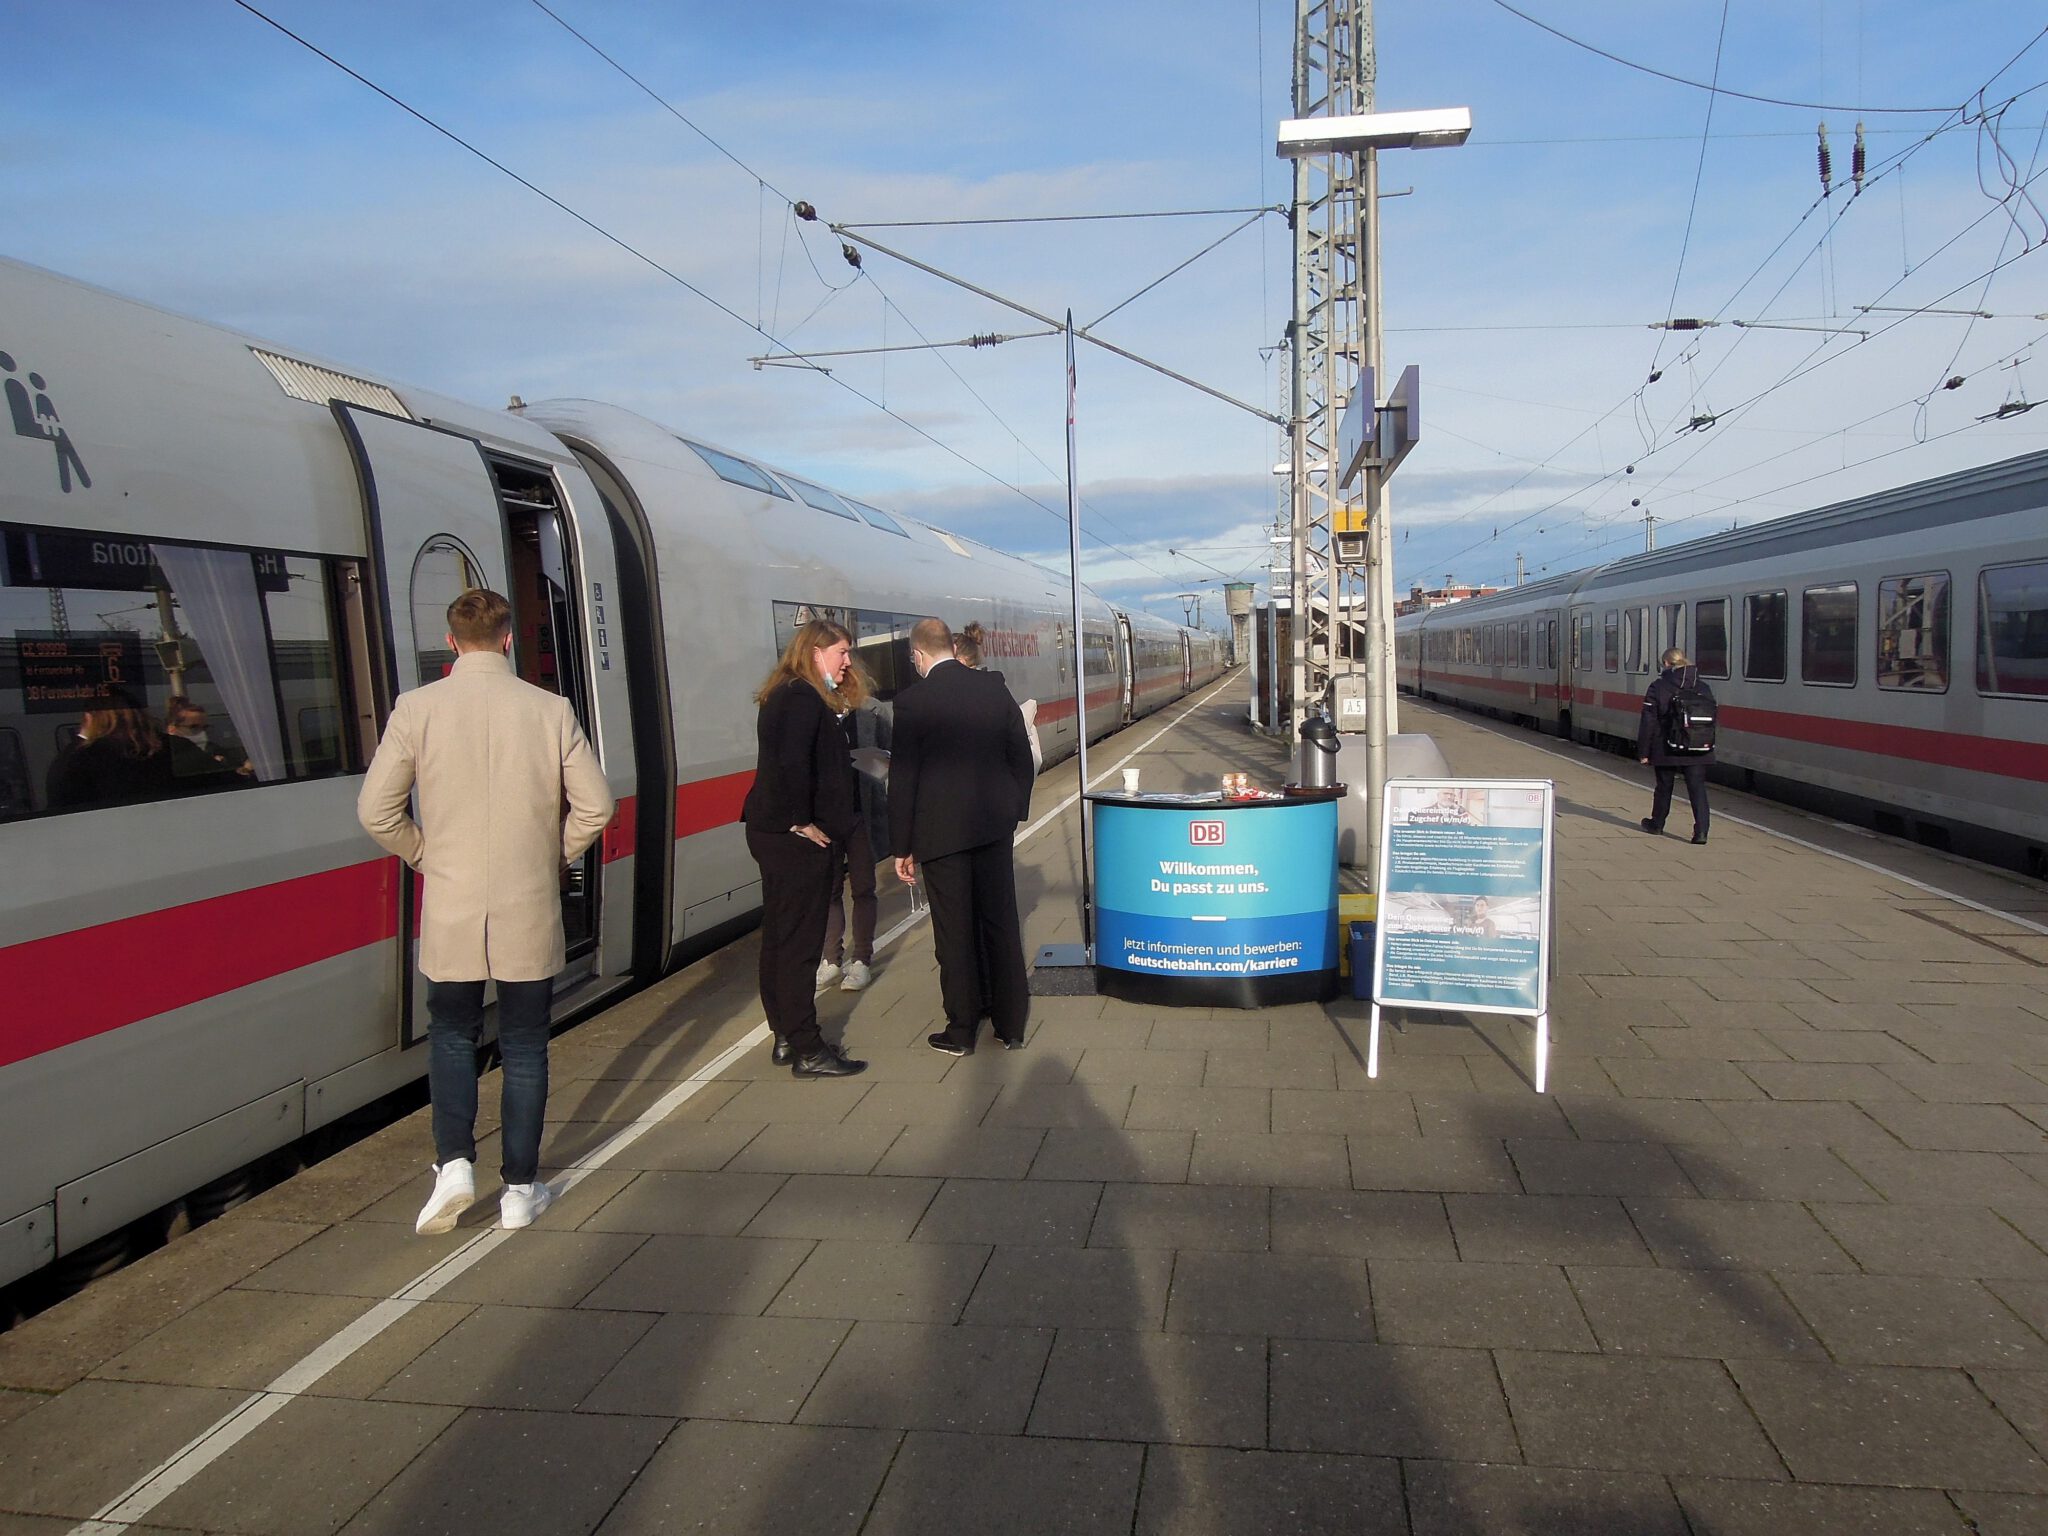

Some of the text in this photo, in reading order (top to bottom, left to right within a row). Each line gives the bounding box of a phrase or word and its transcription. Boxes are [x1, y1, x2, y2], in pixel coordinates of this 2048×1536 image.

[982, 623, 1040, 657] ordrestaurant
[1193, 825, 1221, 842] DB
[1159, 861, 1259, 877] Willkommen,
[1151, 879, 1269, 896] Du passt zu uns.
[1123, 936, 1303, 956] Jetzt informieren und bewerben:
[1128, 954, 1298, 973] deutschebahn.com/karriere
